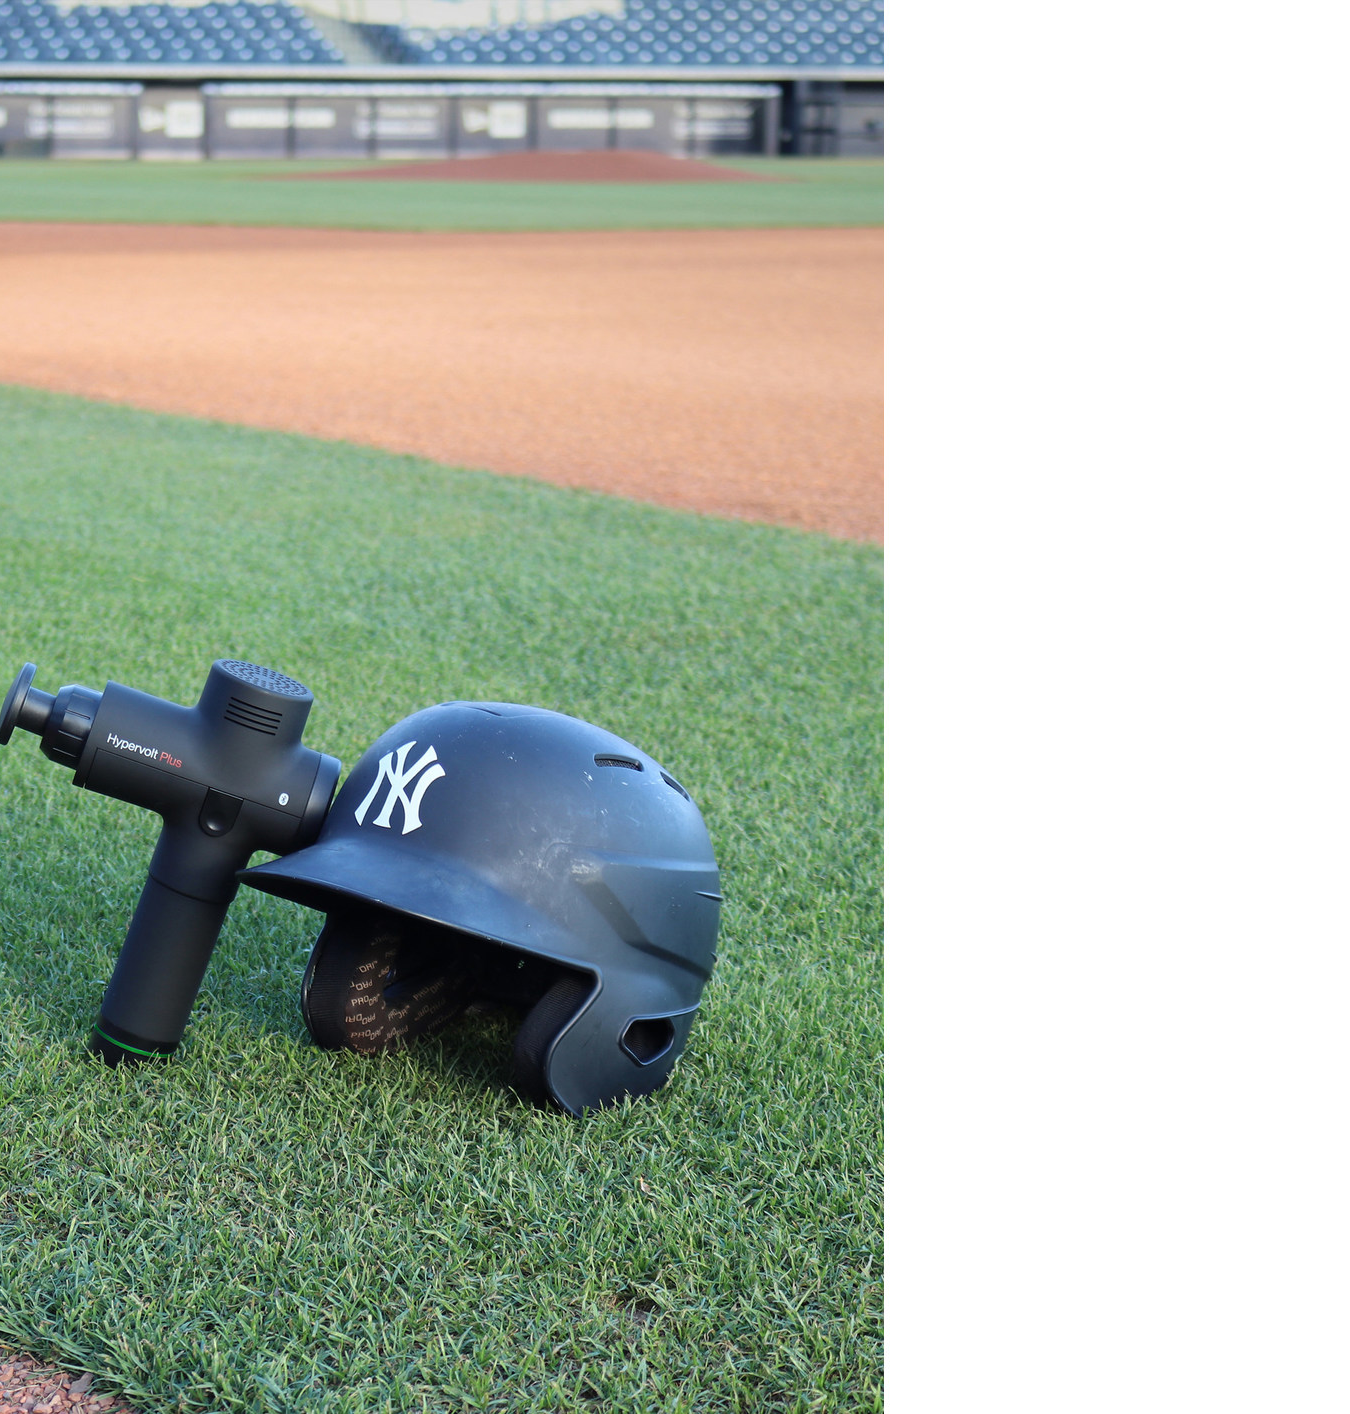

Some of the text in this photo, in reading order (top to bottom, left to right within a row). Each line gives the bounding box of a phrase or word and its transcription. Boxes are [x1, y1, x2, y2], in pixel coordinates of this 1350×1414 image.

[106, 732, 183, 768] Hypervolt Plus
[354, 740, 446, 835] NY
